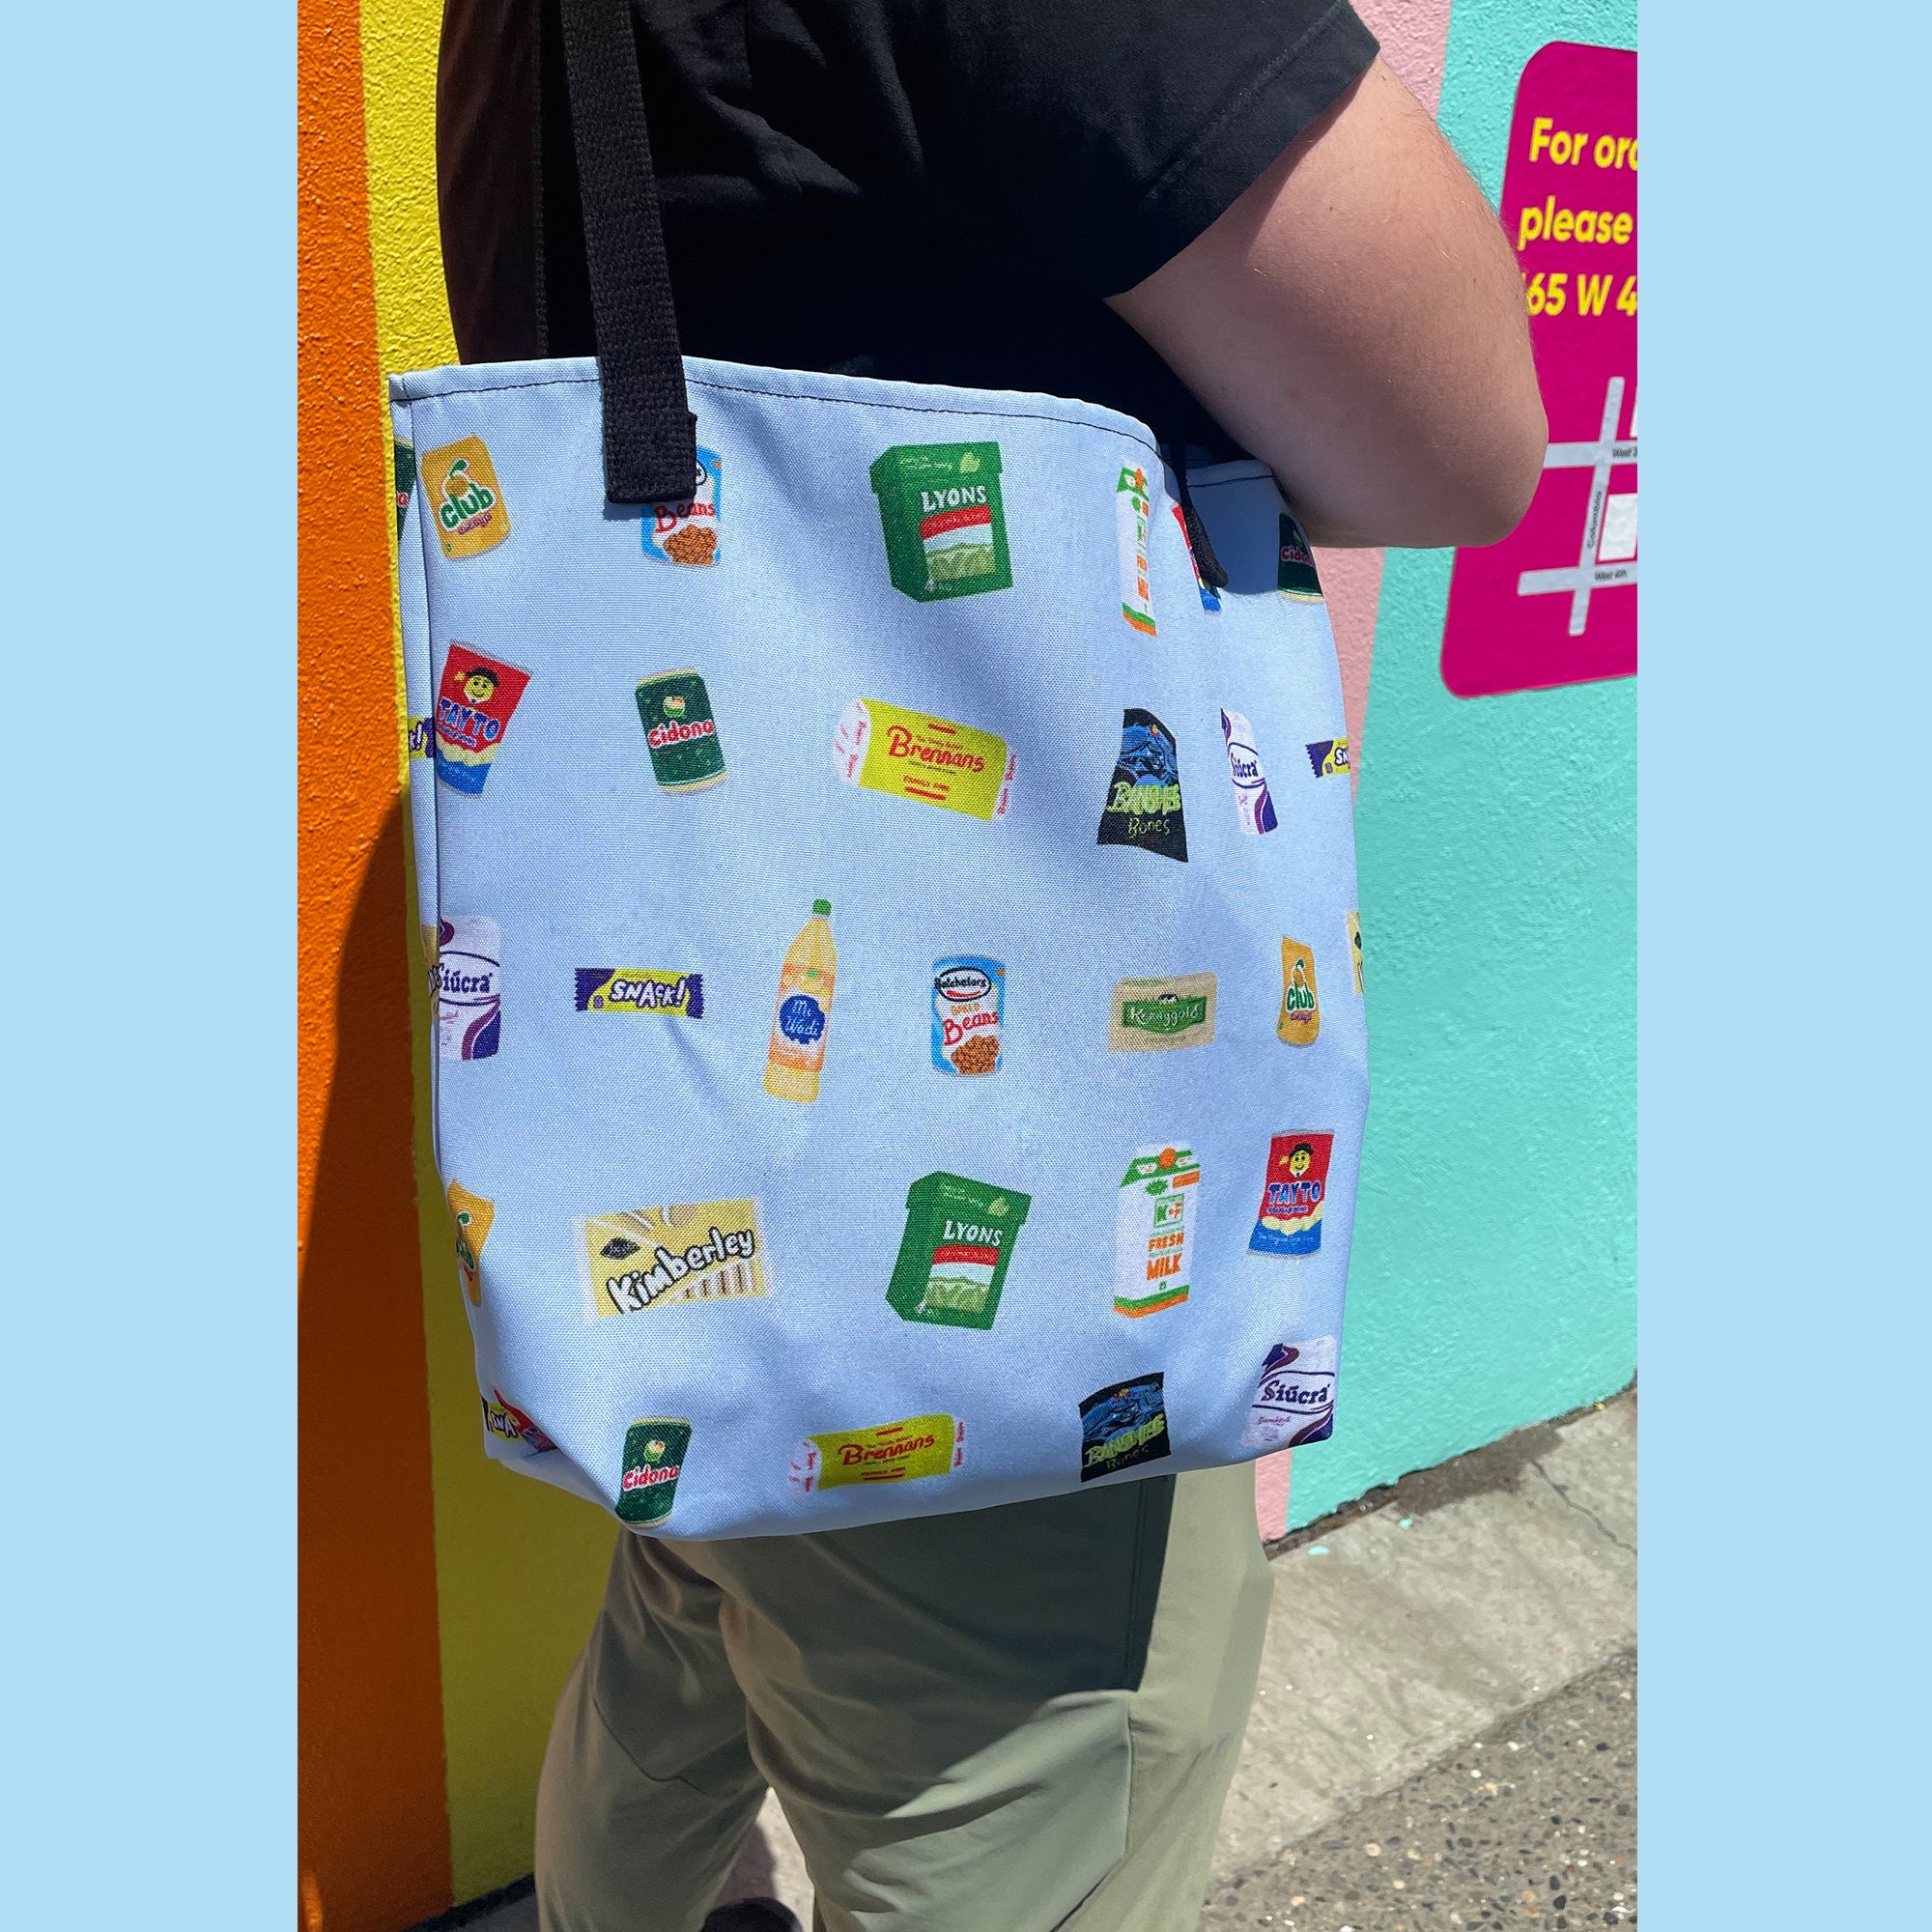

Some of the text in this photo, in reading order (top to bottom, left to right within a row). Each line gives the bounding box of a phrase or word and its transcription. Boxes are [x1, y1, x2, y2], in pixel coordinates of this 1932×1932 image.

[1529, 117, 1588, 166] For
[1518, 195, 1633, 251] please
[1577, 274, 1613, 316] W
[1612, 446, 1632, 458] West
[440, 482, 496, 530] club
[921, 485, 986, 512] LYONS
[1595, 571, 1613, 581] West
[440, 696, 500, 741] TAYTO
[886, 724, 984, 773] Brennans
[1287, 981, 1315, 1011] club
[943, 1011, 999, 1046] Beans
[1268, 1180, 1321, 1205] TAYTO
[943, 1219, 1004, 1247] LYONS
[1148, 1232, 1184, 1253] FRESH
[606, 1225, 756, 1315] Kimberley
[1147, 1252, 1182, 1281] MILK
[1261, 1379, 1331, 1405] Siúcra
[838, 1435, 935, 1466] Brennans
[622, 1463, 680, 1492] Cidona
